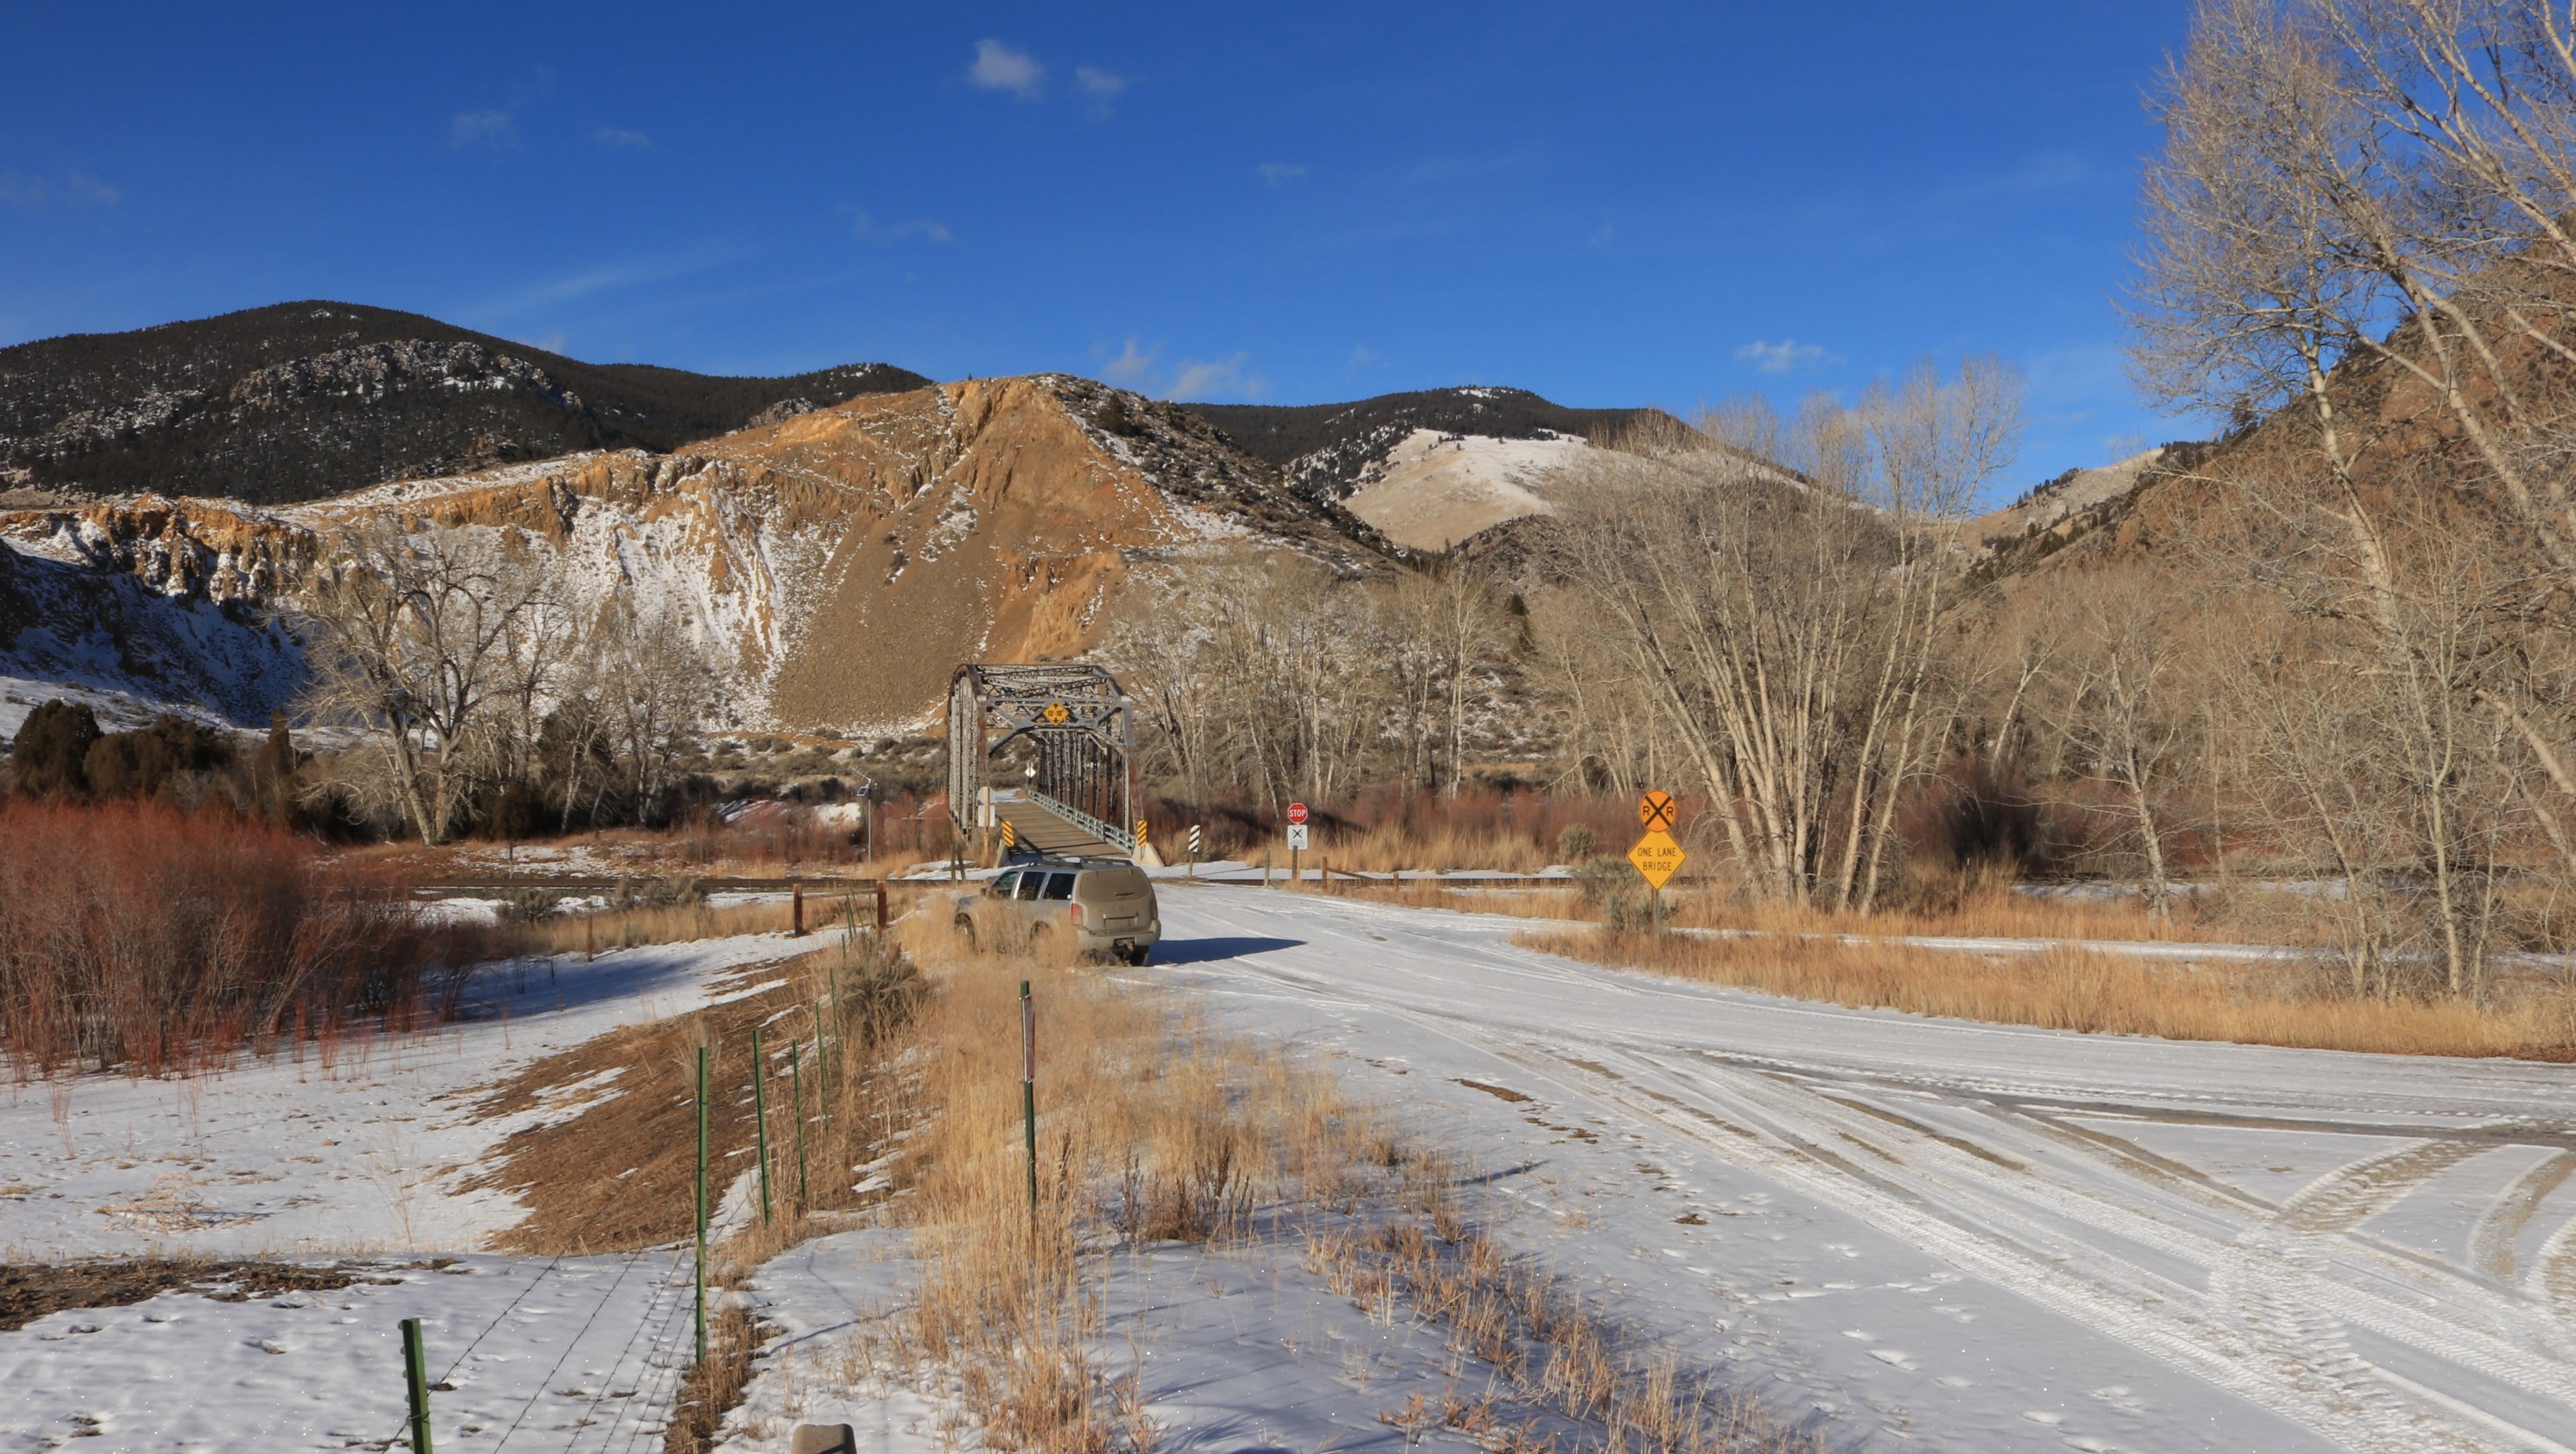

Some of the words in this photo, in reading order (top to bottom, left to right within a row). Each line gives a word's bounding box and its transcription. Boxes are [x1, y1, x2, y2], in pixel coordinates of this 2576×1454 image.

[1637, 847, 1652, 857] ONE
[1658, 847, 1677, 857] LANE
[1642, 861, 1672, 872] BRIDGE
